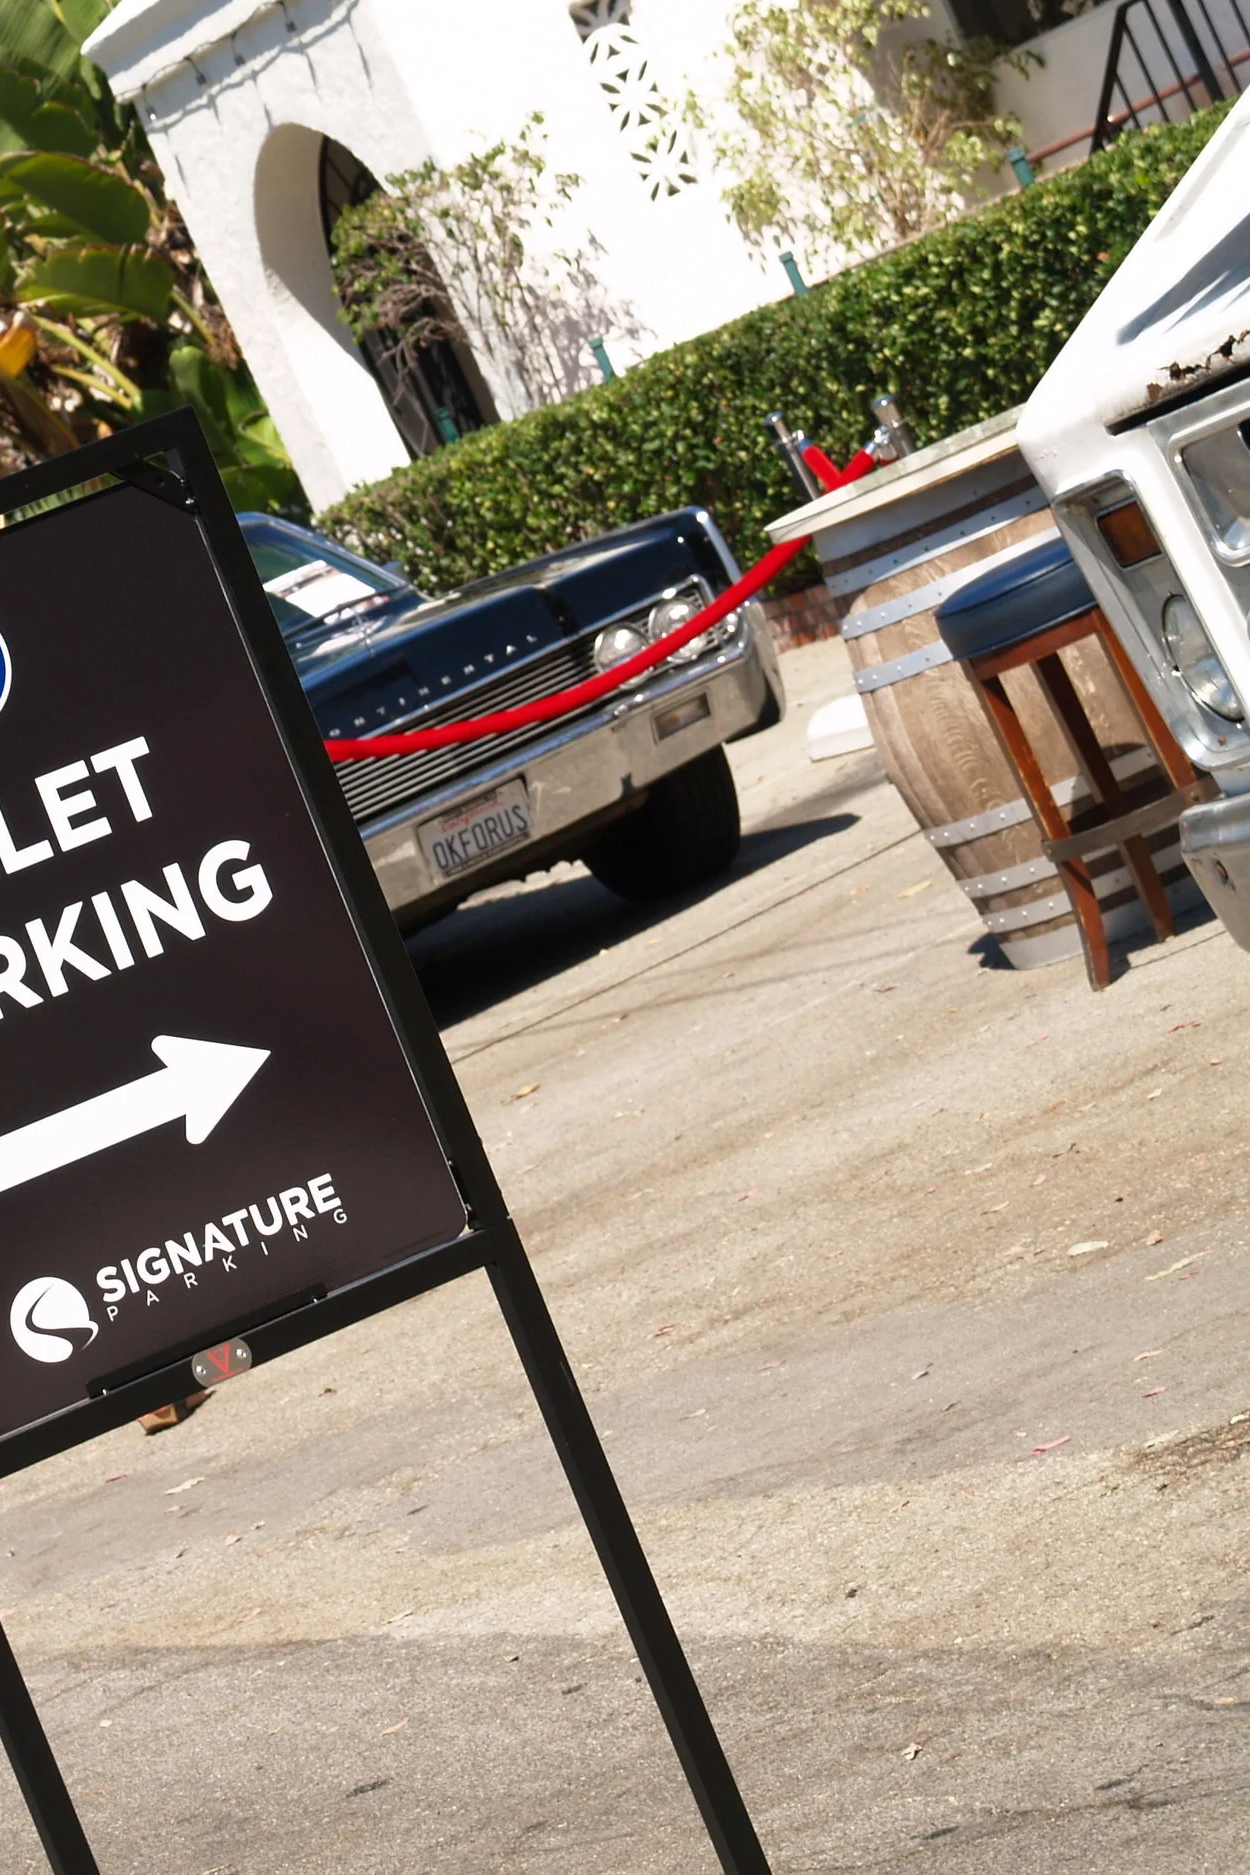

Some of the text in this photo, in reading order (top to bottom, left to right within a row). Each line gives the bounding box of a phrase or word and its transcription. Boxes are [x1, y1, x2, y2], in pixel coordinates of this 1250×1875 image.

[329, 634, 538, 737] ONTINENTAL
[432, 804, 527, 871] OKFORUS
[96, 1172, 342, 1303] SIGNATURE
[105, 1208, 348, 1322] PARKING
